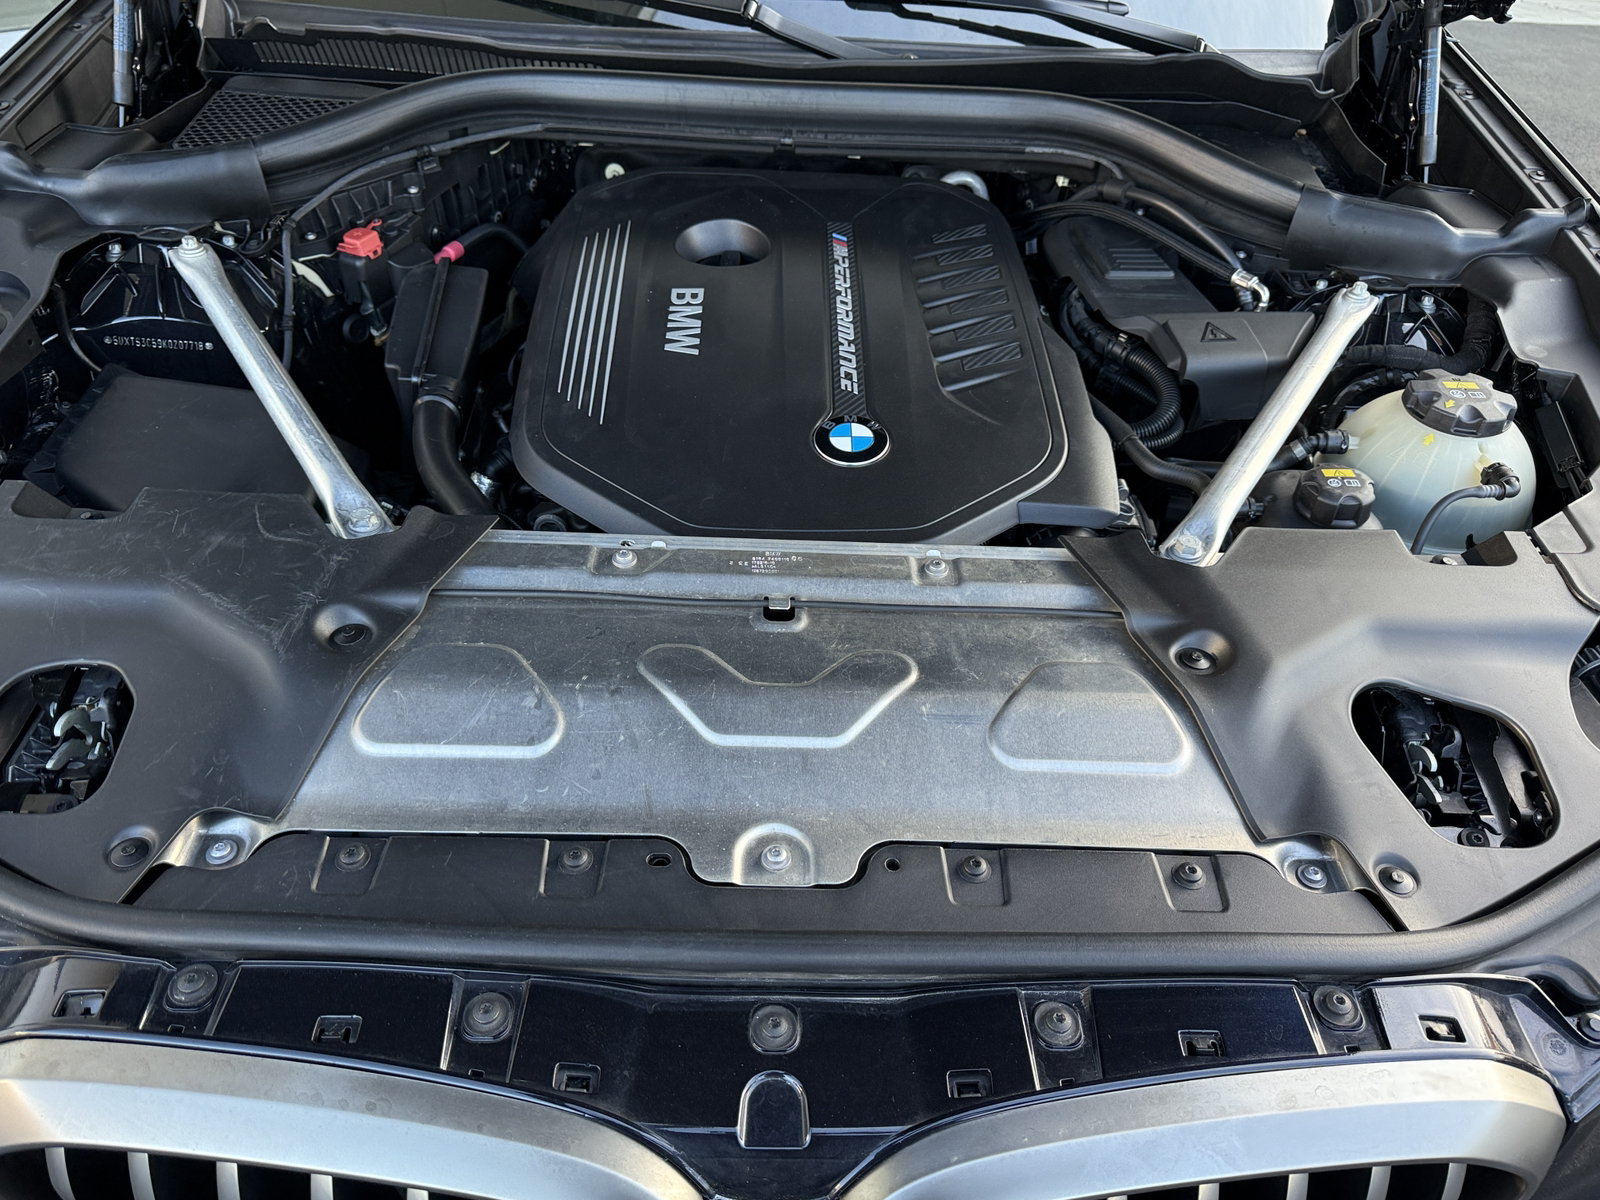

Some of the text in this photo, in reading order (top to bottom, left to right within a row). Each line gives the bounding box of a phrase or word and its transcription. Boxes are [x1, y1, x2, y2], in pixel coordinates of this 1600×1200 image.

[664, 287, 705, 356] BMW
[833, 255, 860, 395] PERFORMANCE
[822, 414, 883, 431] BMW
